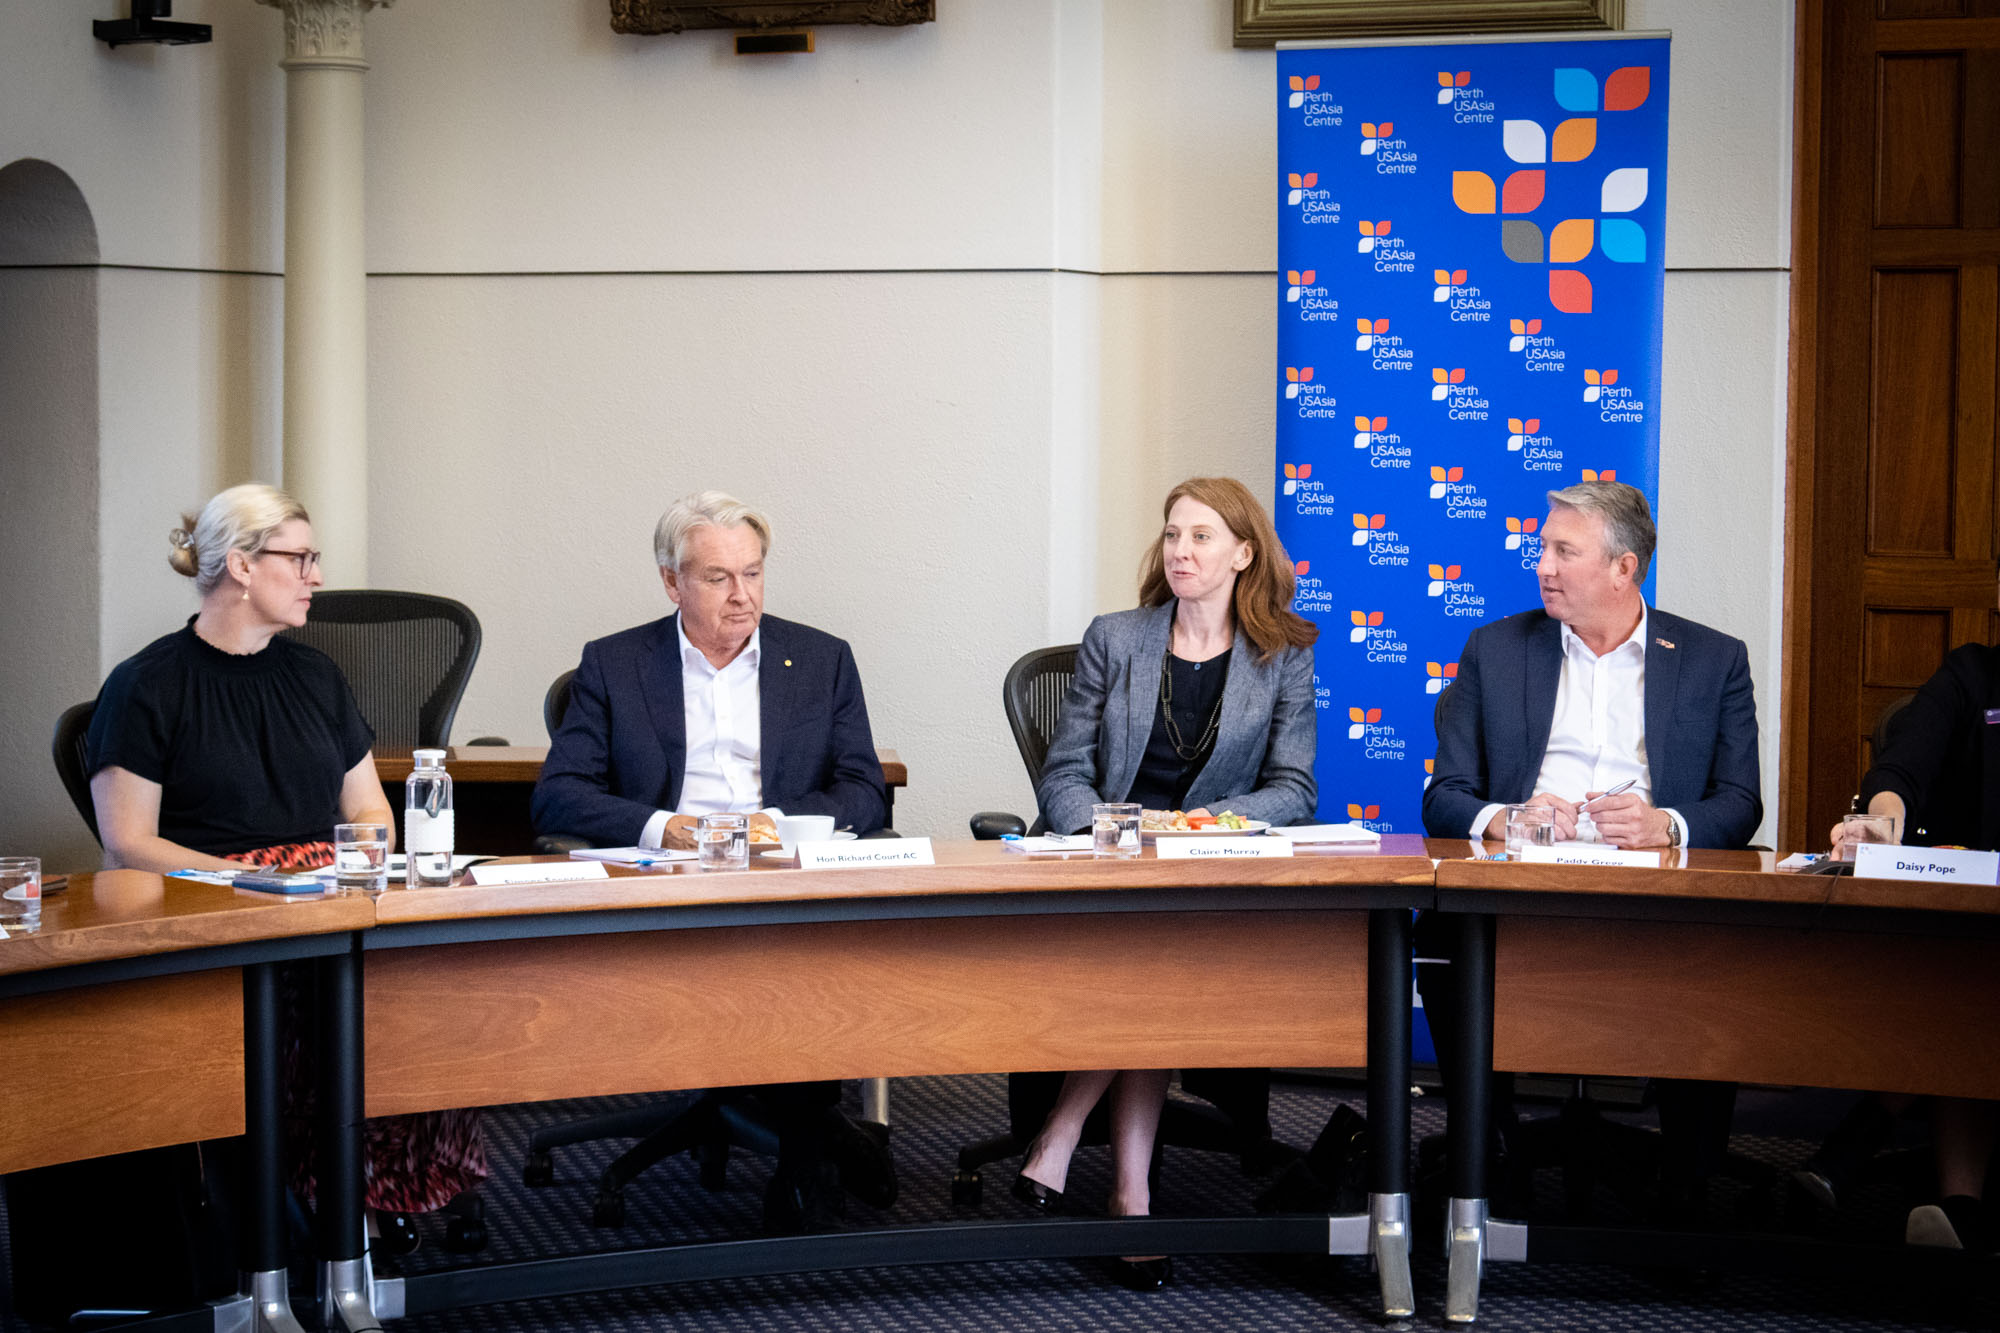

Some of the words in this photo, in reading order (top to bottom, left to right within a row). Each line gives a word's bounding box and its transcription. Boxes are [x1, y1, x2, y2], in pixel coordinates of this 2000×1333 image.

[1303, 92, 1332, 102] Perth
[1455, 88, 1483, 98] Perth
[1304, 104, 1342, 115] USAsia
[1454, 100, 1494, 111] USAsia
[1304, 116, 1342, 126] Centre
[1454, 113, 1494, 123] Centre
[1376, 139, 1406, 149] Perth
[1377, 151, 1417, 162] USAsia
[1377, 163, 1416, 174] Centre
[1303, 189, 1330, 199] Perth
[1303, 201, 1340, 212] USAsia
[1302, 213, 1340, 224] Centre
[1374, 237, 1404, 247] Perth
[1375, 249, 1415, 260] USAsia
[1375, 261, 1414, 272] Centre
[1300, 286, 1328, 296] Perth
[1451, 286, 1480, 297] Perth
[1301, 298, 1338, 309] USAsia
[1451, 299, 1491, 309] USAsia
[1301, 310, 1337, 321] Centre
[1451, 310, 1490, 321] Centre
[1373, 335, 1402, 346] Perth
[1526, 336, 1554, 346] Perth
[1373, 347, 1413, 358] USAsia
[1526, 348, 1565, 359] USAsia
[1373, 359, 1413, 370] Centre
[1526, 360, 1564, 371] Centre
[1298, 384, 1325, 394] Perth
[1449, 385, 1478, 395] Perth
[1601, 386, 1632, 397] Perth
[1299, 396, 1336, 406] USAsia
[1449, 397, 1488, 408] USAsia
[1601, 399, 1643, 410] USAsia
[1299, 407, 1335, 418] Centre
[1449, 409, 1488, 420] Centre
[1601, 411, 1643, 422] Centre
[1370, 433, 1400, 443] Perth
[1524, 435, 1552, 446] Perth
[1371, 445, 1411, 456] USAsia
[1524, 448, 1563, 459] USAsia
[1371, 457, 1411, 468] Centre
[1524, 460, 1562, 471] Centre
[1296, 480, 1323, 490] Perth
[1447, 483, 1476, 494] Perth
[1297, 492, 1334, 503] USAsia
[1447, 496, 1486, 507] USAsia
[1297, 504, 1333, 515] Centre
[1447, 507, 1486, 518] Centre
[1368, 530, 1398, 541] Perth
[1522, 534, 1542, 545] Per
[1369, 543, 1409, 554] USAsia
[1522, 547, 1544, 558] USA
[1369, 554, 1408, 566] Centre
[1296, 576, 1322, 588] Perth
[1445, 581, 1474, 592] Perth
[1445, 594, 1484, 605] USAsia
[1295, 600, 1332, 612] Centre
[1445, 605, 1484, 617] Centre
[1368, 627, 1396, 638] Perth
[1367, 640, 1407, 651] USAsia
[1367, 651, 1406, 663] Centre
[1366, 724, 1394, 735] Perth
[1366, 737, 1405, 748] USAsia
[1365, 748, 1404, 760] Centre
[1364, 820, 1393, 832] Perth
[816, 855, 836, 863] Hon
[838, 854, 872, 862] Richard
[874, 853, 900, 861] Court
[1189, 848, 1220, 856] Claire
[1223, 848, 1261, 857] Murray
[1896, 861, 1926, 874] Daisy
[1928, 863, 1956, 875] Pope
